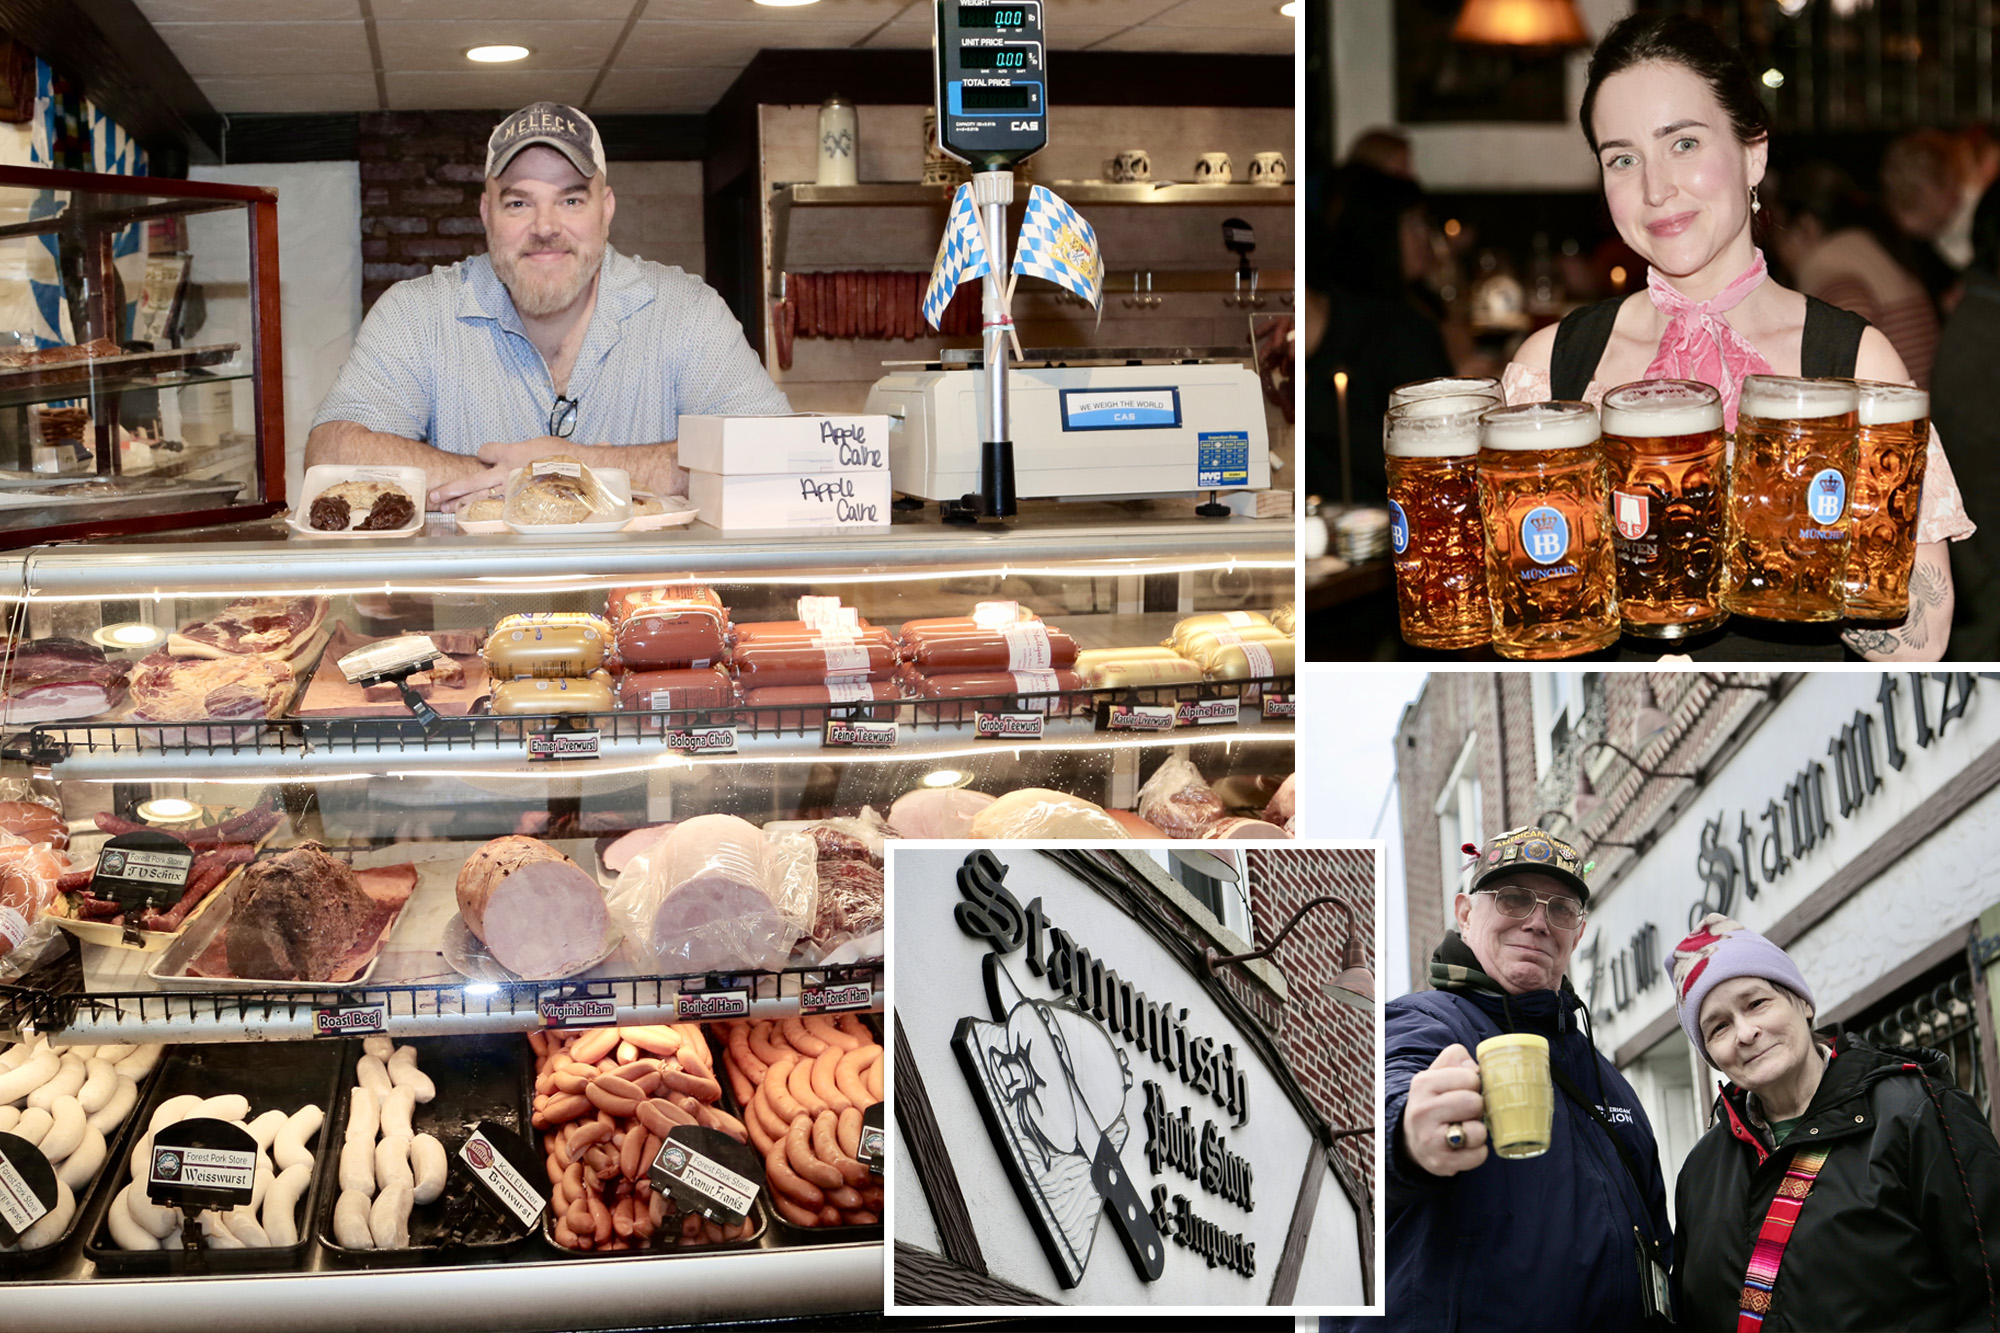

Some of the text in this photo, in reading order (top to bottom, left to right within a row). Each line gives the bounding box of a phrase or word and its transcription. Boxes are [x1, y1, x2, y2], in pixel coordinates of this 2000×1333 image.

[505, 114, 579, 140] MELECK
[1011, 121, 1039, 131] CAS
[1114, 413, 1136, 421] CAS
[820, 420, 866, 445] Apple
[800, 477, 855, 502] Apple
[1817, 495, 1839, 516] HB
[1532, 533, 1561, 556] HB
[1520, 565, 1578, 580] MÜNCHEN
[1179, 705, 1235, 719] Alpine Ham
[980, 718, 1040, 732] Grobe Teewurst
[1138, 715, 1171, 726] Liverwurst
[670, 733, 731, 748] Bologna Chub
[831, 728, 895, 742] Feine Teewurst
[531, 738, 596, 752] Ehmer Liverwurst
[1494, 830, 1545, 848] AMERICAN
[130, 853, 184, 866] Forest Pork Store
[803, 989, 868, 1005] Black Forest Ham
[542, 1003, 613, 1018] Virginia Ham
[680, 1000, 743, 1014] Boiled Ham
[319, 1012, 380, 1028] Roast Beef
[1608, 1106, 1632, 1114] ERICAN
[1143, 1079, 1256, 1213] Pork Store
[186, 1151, 248, 1165] Forest Pork Store
[185, 1167, 246, 1185] Weisswurst
[692, 1156, 750, 1192] Forest Pork Store
[0, 1164, 17, 1185] Forest
[13, 1180, 26, 1197] Pork
[23, 1195, 39, 1213] Store
[498, 1162, 538, 1205] Karl Ehmer
[682, 1168, 744, 1210] Peanut Franks
[488, 1171, 532, 1219] Bratwurst
[1150, 1183, 1257, 1278] & Imports
